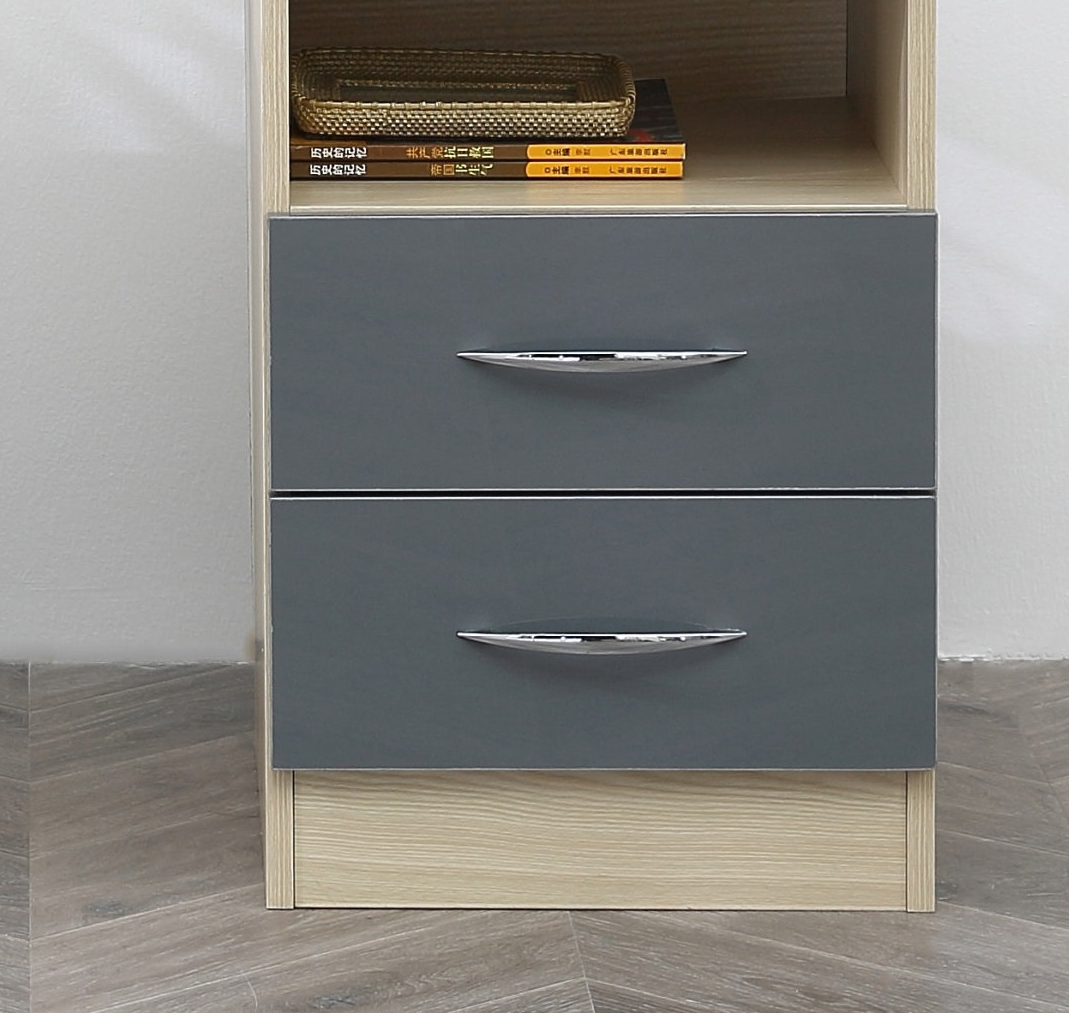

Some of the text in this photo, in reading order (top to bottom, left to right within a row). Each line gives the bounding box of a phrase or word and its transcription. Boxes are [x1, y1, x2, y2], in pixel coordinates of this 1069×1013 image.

[310, 146, 368, 159] 历史的记忆
[309, 163, 367, 176] 历史的记忆
